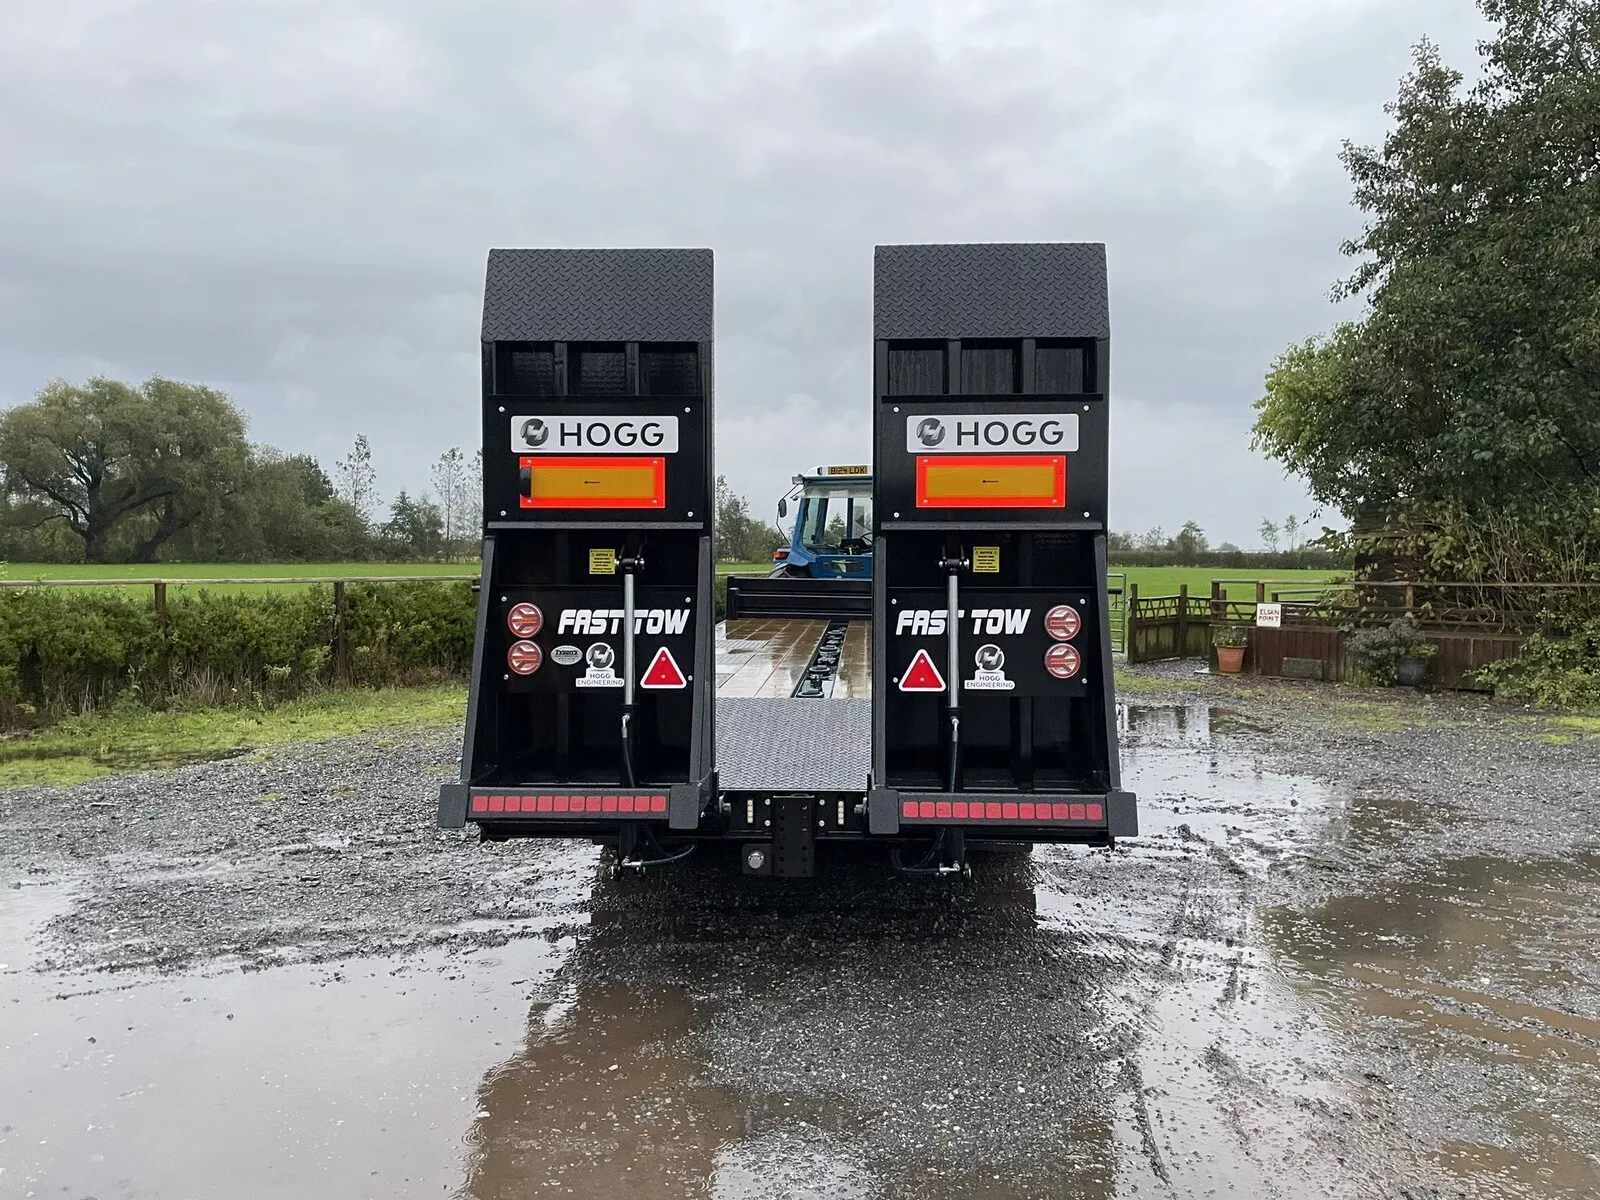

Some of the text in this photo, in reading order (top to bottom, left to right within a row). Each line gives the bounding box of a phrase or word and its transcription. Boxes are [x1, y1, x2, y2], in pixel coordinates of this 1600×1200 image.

[560, 422, 664, 447] HOGG
[956, 420, 1064, 446] HOGG
[633, 609, 691, 635] TOW
[895, 608, 1032, 636] FAS TOW
[966, 681, 1014, 689] ENGINEERING
